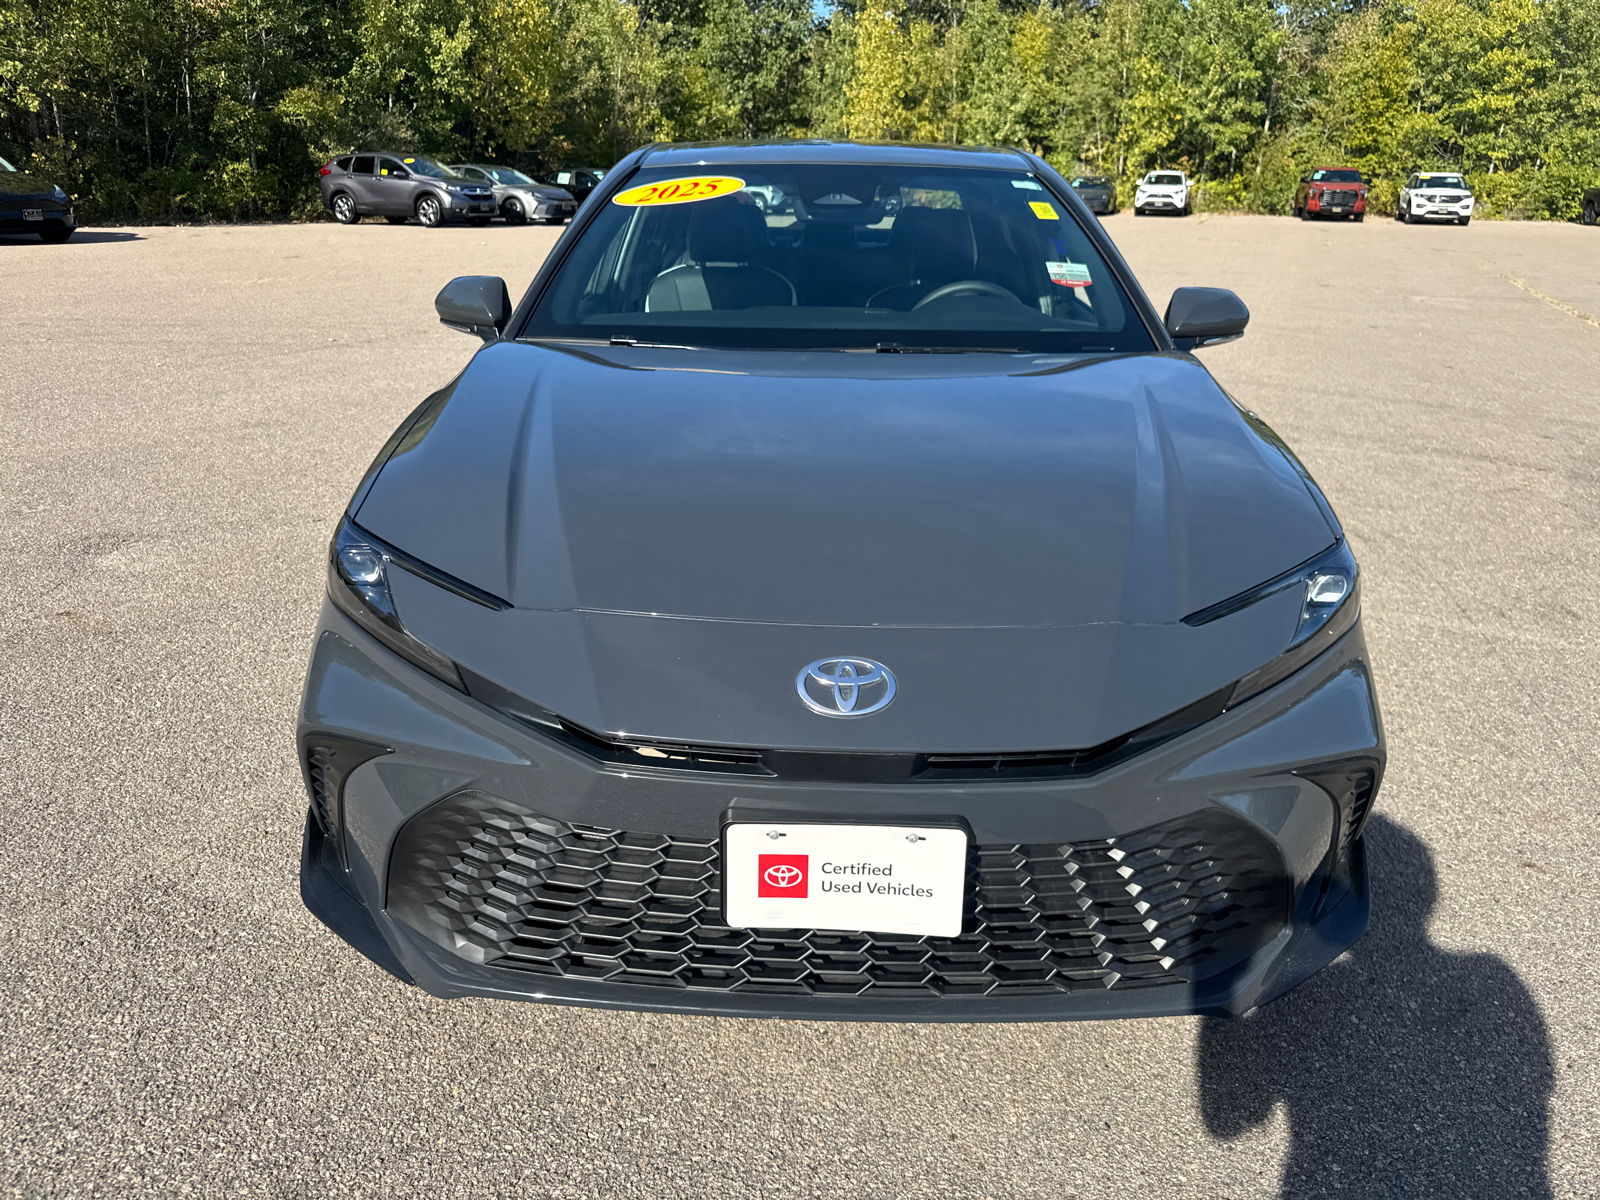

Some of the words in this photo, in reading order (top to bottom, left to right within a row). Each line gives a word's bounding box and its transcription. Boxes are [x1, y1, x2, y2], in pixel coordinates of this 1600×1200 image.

[634, 180, 723, 203] 2025
[821, 862, 893, 877] Certified
[821, 881, 862, 894] Used
[866, 882, 934, 898] Vehicles
